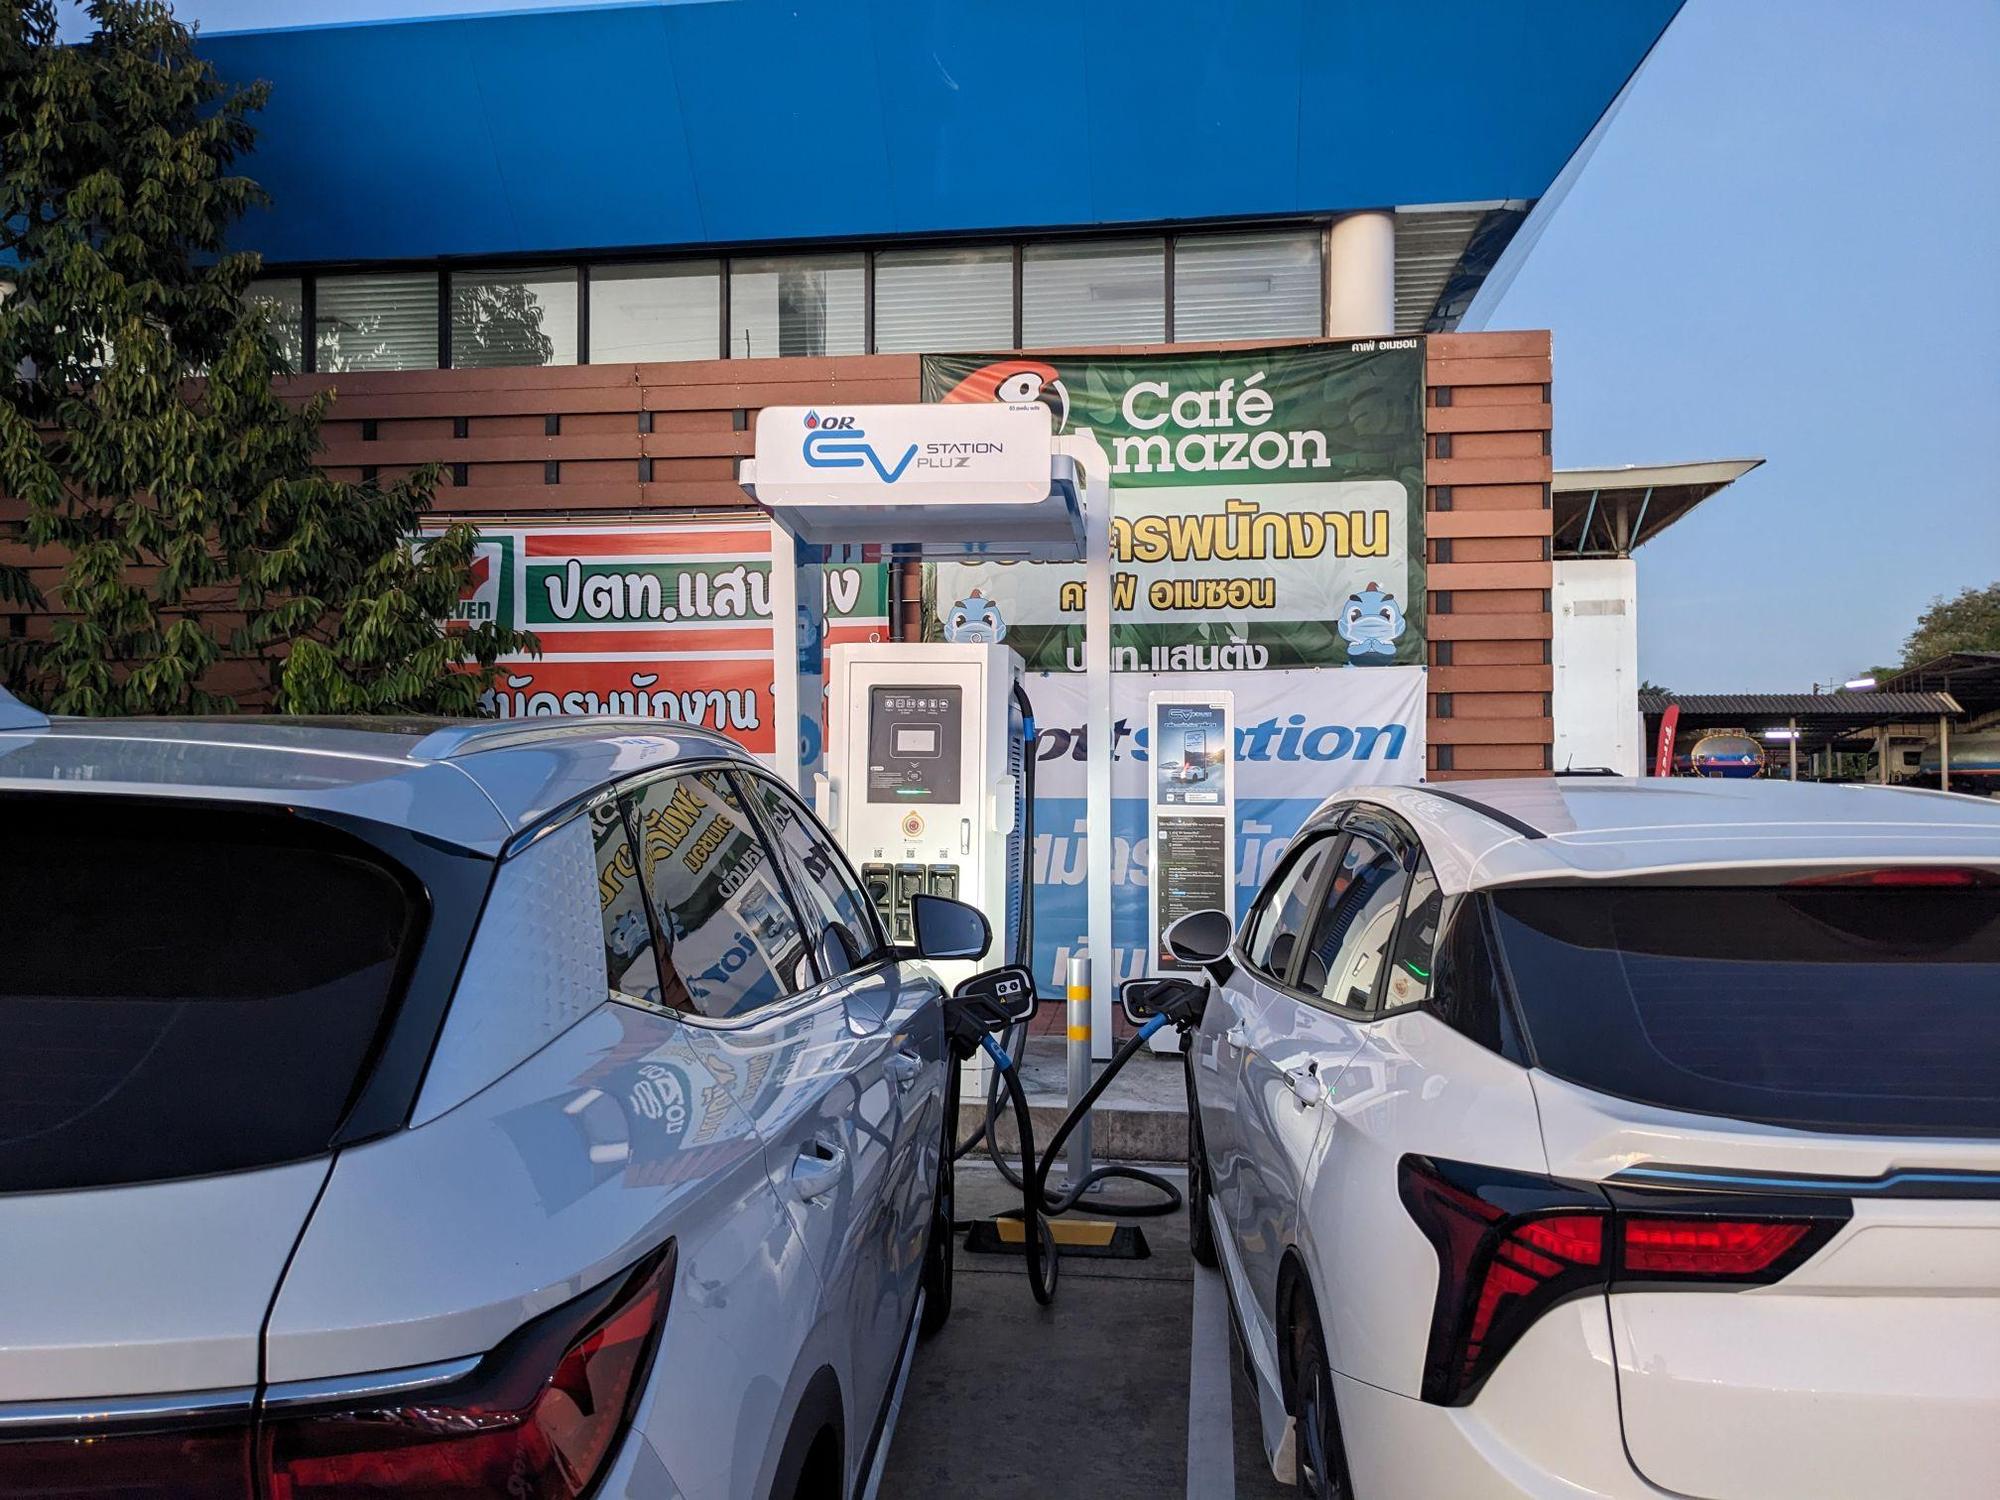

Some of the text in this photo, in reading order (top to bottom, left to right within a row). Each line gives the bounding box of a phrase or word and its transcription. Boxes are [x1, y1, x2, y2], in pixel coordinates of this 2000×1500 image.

[1122, 371, 1273, 430] Café
[821, 416, 855, 430] OR
[803, 430, 1003, 484] EV STATION
[917, 457, 971, 468] PLUZ
[1075, 428, 1331, 474] mazon
[1149, 577, 1276, 610] อเมซอน
